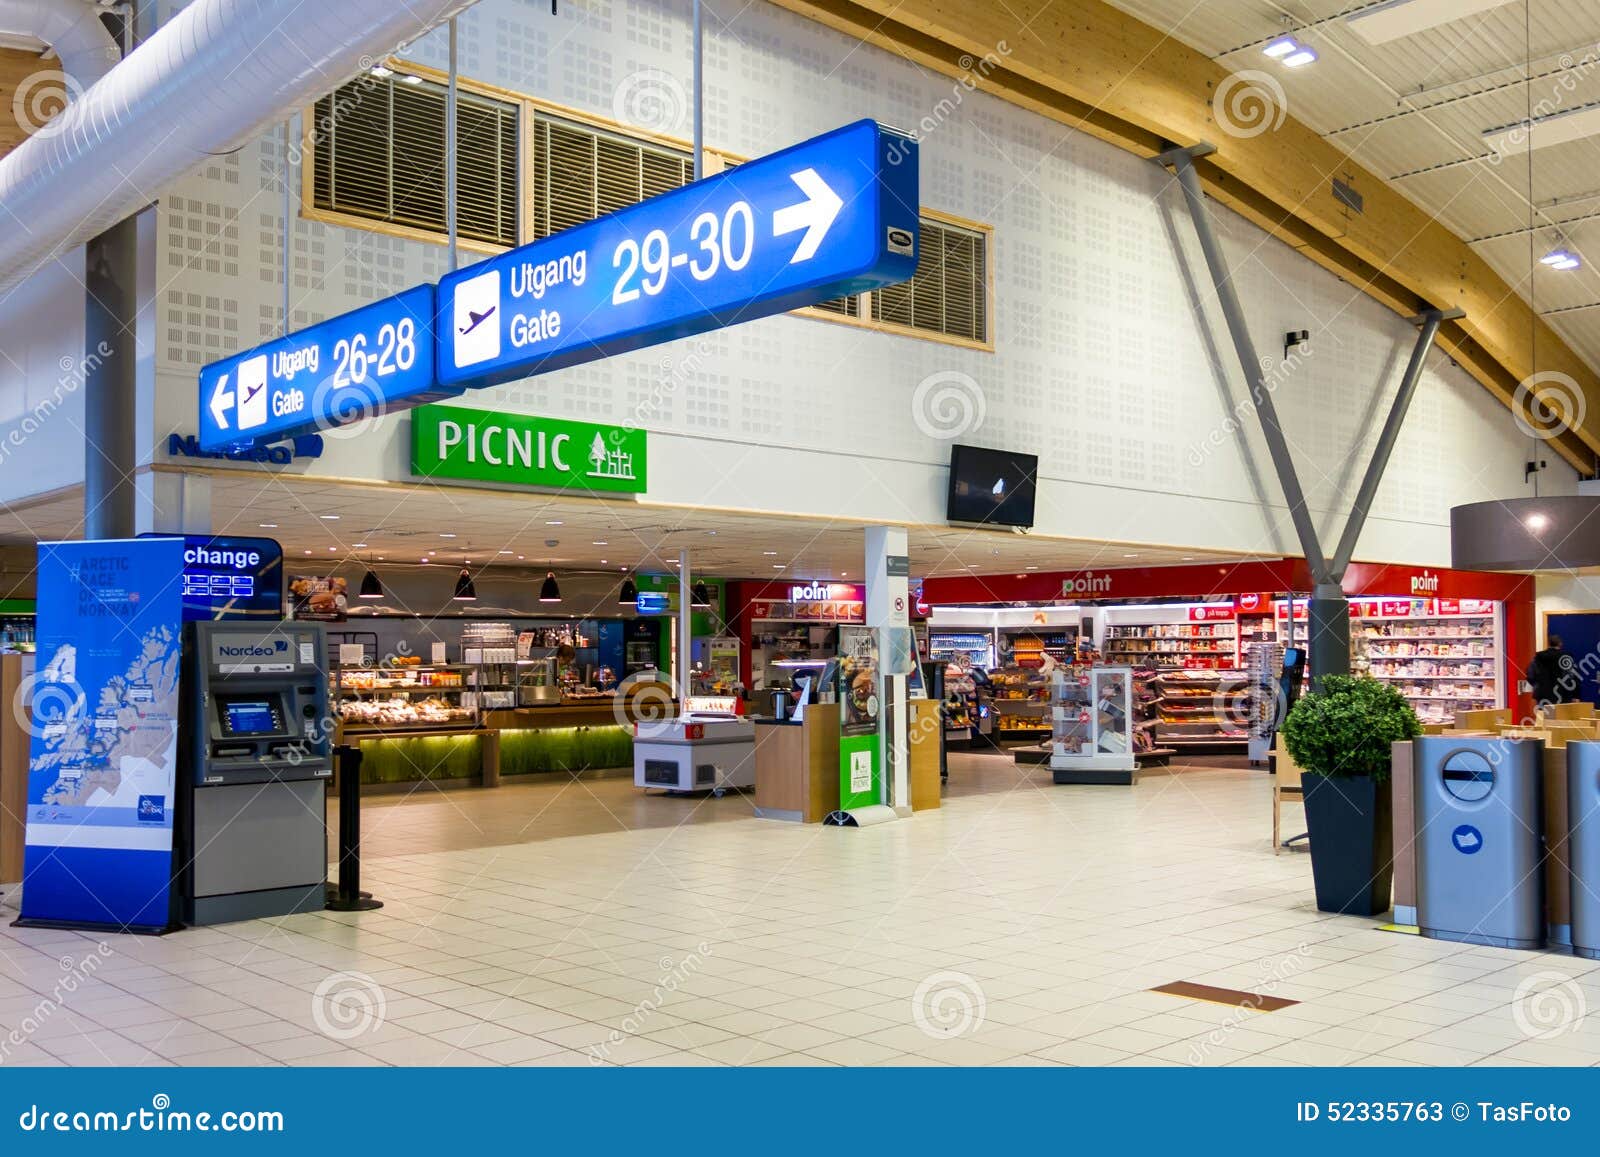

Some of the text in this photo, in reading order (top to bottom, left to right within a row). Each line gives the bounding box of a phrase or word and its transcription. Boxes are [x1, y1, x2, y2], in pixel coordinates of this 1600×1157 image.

[611, 200, 755, 306] 29-30
[510, 249, 587, 299] Utgang
[510, 308, 562, 348] Gate
[272, 344, 319, 381] Utgang
[332, 317, 416, 391] 26-28
[272, 388, 304, 417] Gate
[438, 421, 570, 472] PICNIC
[81, 557, 129, 571] ARCTIC
[80, 572, 117, 586] RACE
[792, 581, 832, 603] point
[1062, 571, 1112, 598] point
[1411, 569, 1438, 594] point
[79, 603, 139, 616] NORWAY
[219, 645, 274, 657] Nordea
